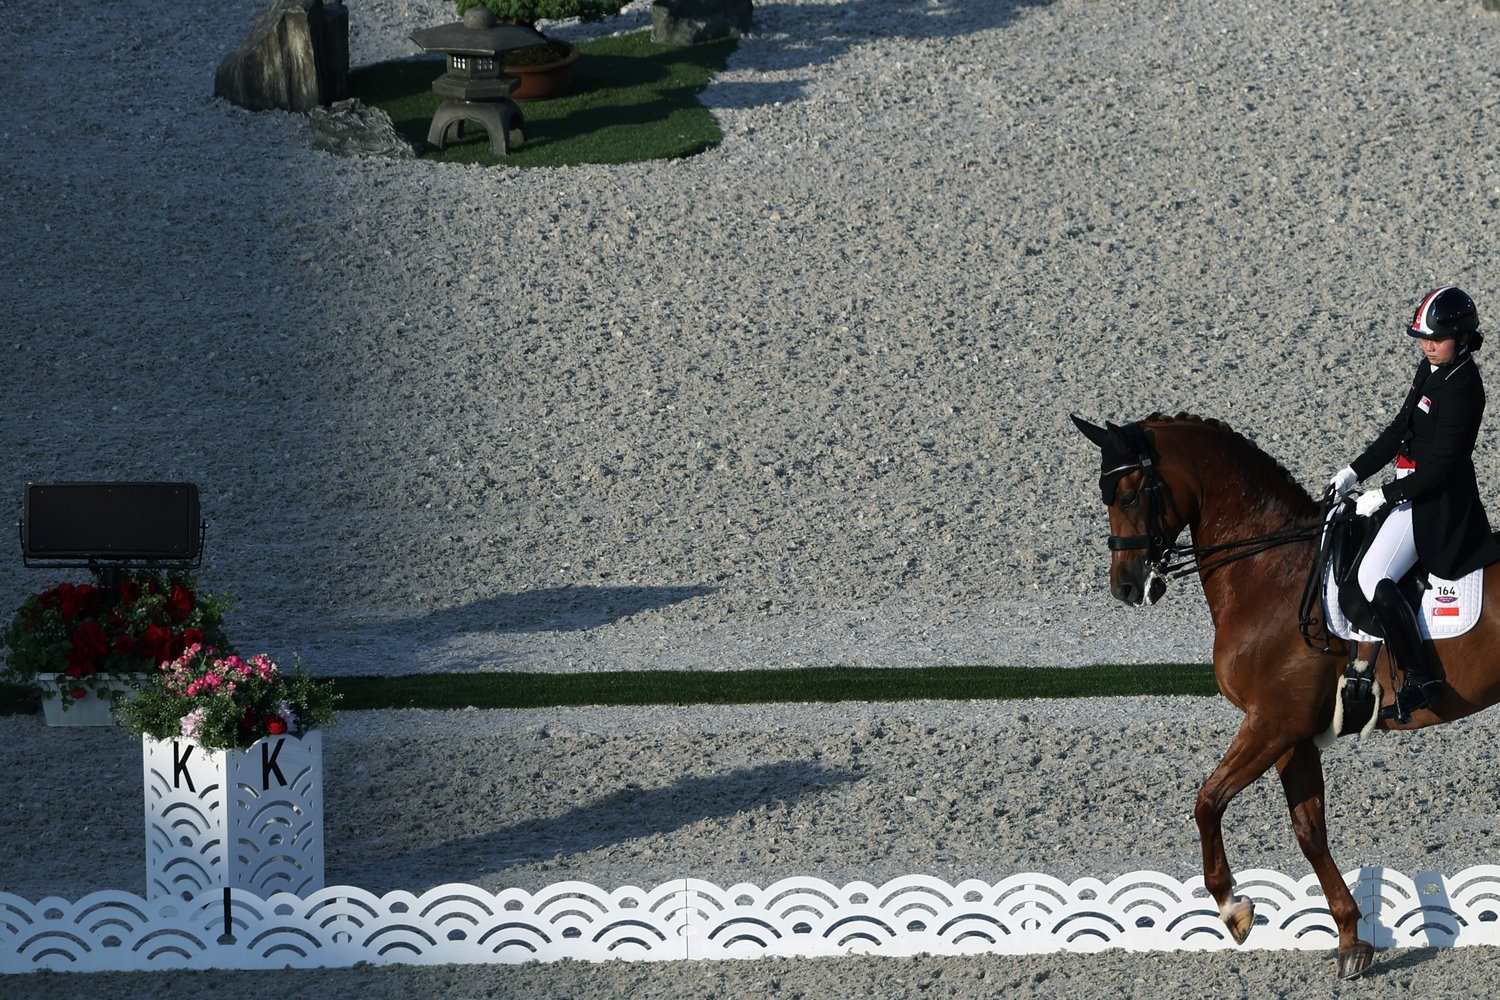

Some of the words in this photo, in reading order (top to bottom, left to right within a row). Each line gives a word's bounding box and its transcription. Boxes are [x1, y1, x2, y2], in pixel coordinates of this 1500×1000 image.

[1437, 586, 1456, 596] 164
[173, 740, 197, 793] K
[262, 738, 288, 791] K
